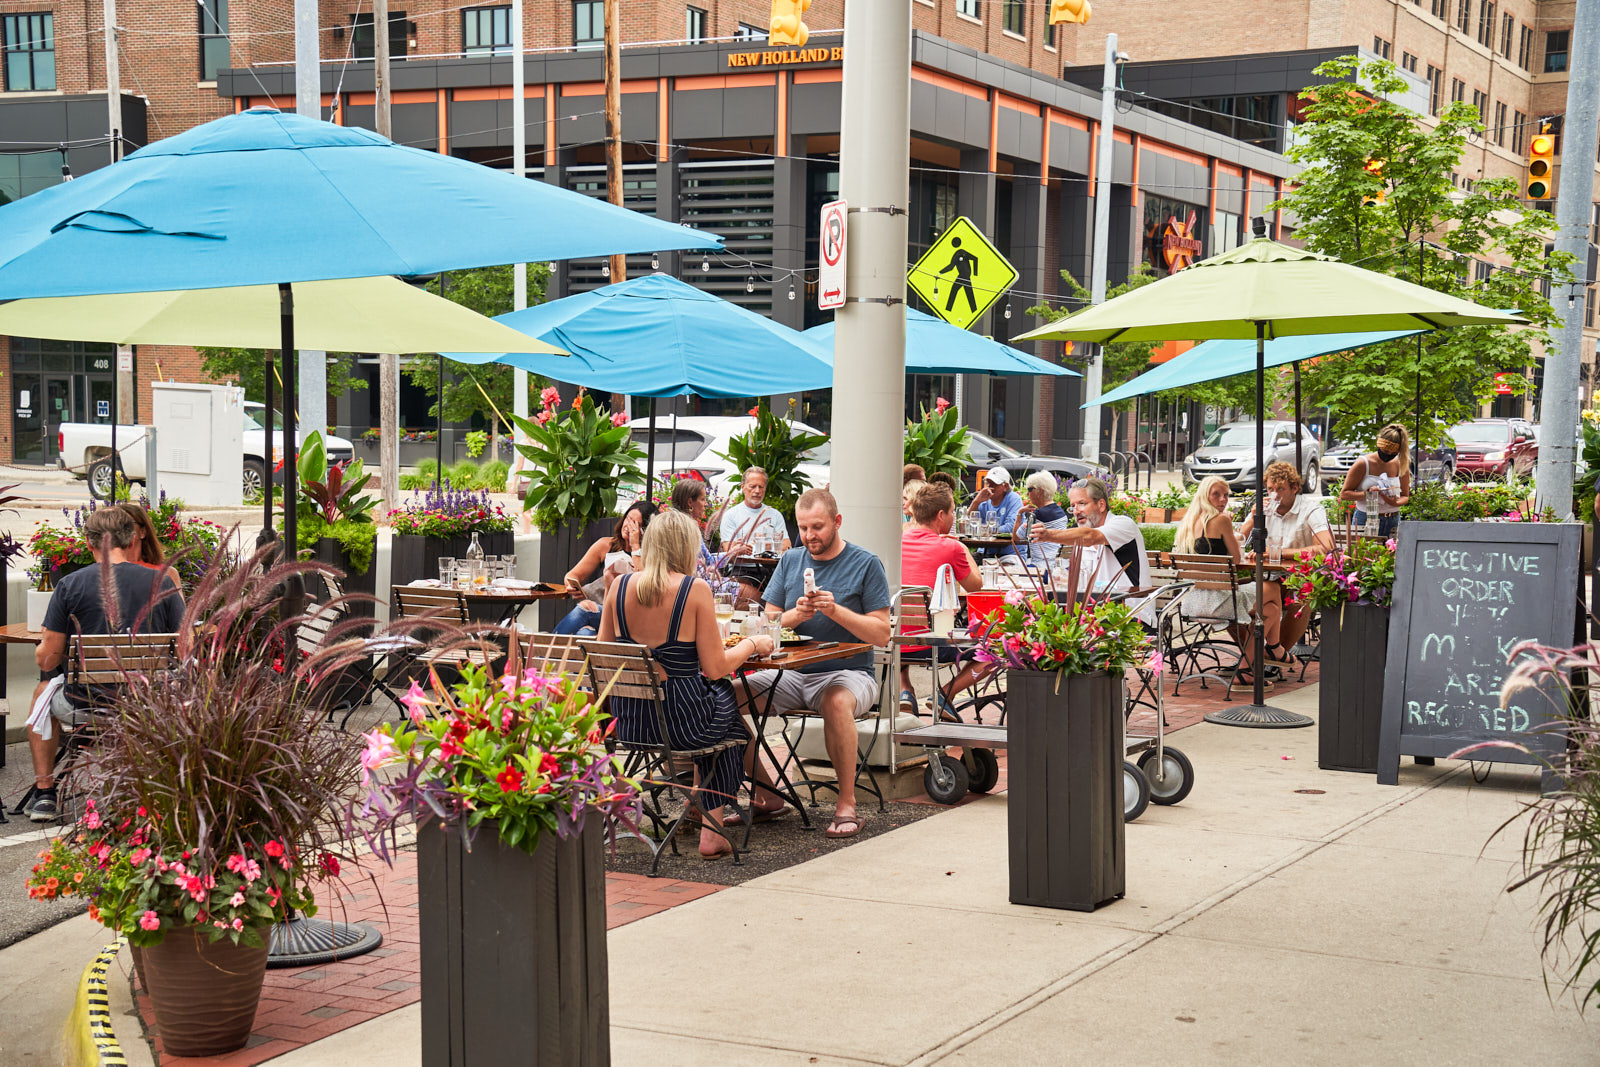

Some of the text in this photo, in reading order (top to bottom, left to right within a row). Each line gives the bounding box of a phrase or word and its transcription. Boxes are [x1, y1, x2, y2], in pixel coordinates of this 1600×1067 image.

[727, 51, 761, 67] NEW
[762, 47, 829, 64] HOLLAND
[94, 359, 109, 369] 408
[1441, 577, 1515, 605] ORDER
[1421, 633, 1538, 667] MKS
[1407, 700, 1530, 732] REQRED
